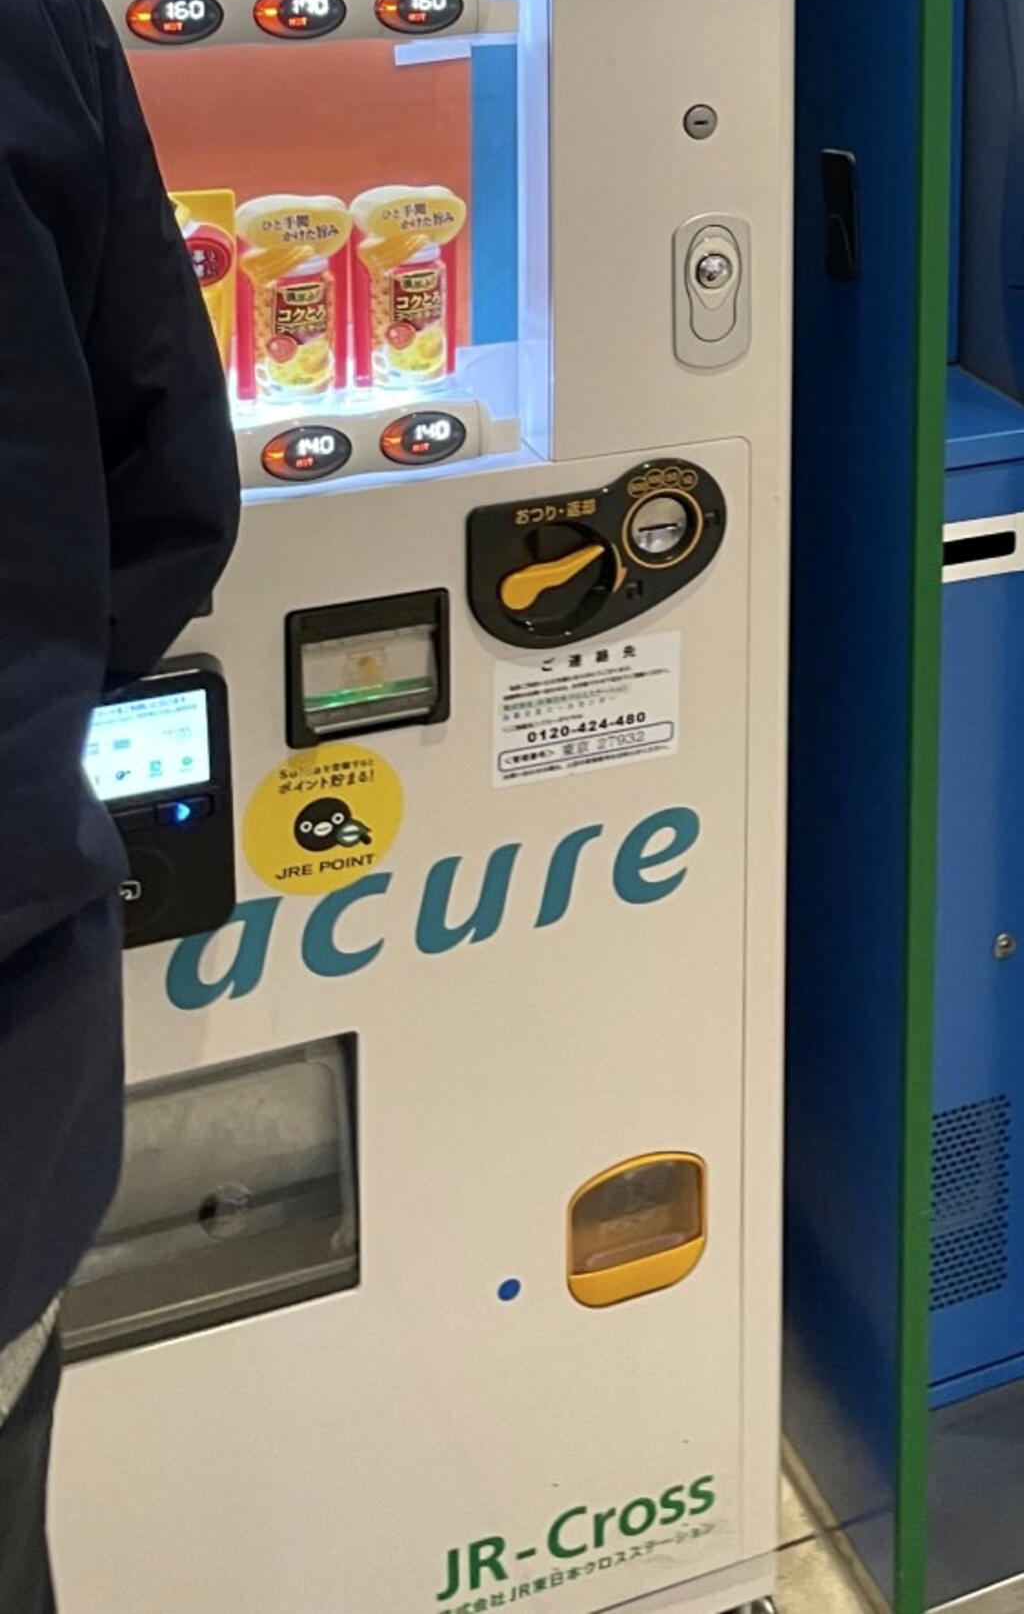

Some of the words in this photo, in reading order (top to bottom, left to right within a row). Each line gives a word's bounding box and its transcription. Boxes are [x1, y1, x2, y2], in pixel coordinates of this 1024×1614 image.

[165, 0, 205, 18] 160
[408, 13, 426, 22] HOT
[163, 22, 183, 31] HOT
[289, 18, 308, 26] HOT
[262, 214, 310, 230] ひと手間
[400, 214, 455, 230] かけた旨み
[283, 225, 339, 242] かけた旨み
[414, 420, 450, 441] 140
[296, 436, 335, 456] 140
[527, 712, 647, 743] 0120-424-480
[597, 730, 645, 750] 27932
[278, 769, 375, 795] ポイント貯まる!
[275, 863, 314, 880] JRE
[319, 853, 375, 873] POINT
[166, 807, 700, 1010] acure
[436, 1475, 715, 1601] JR-Cross
